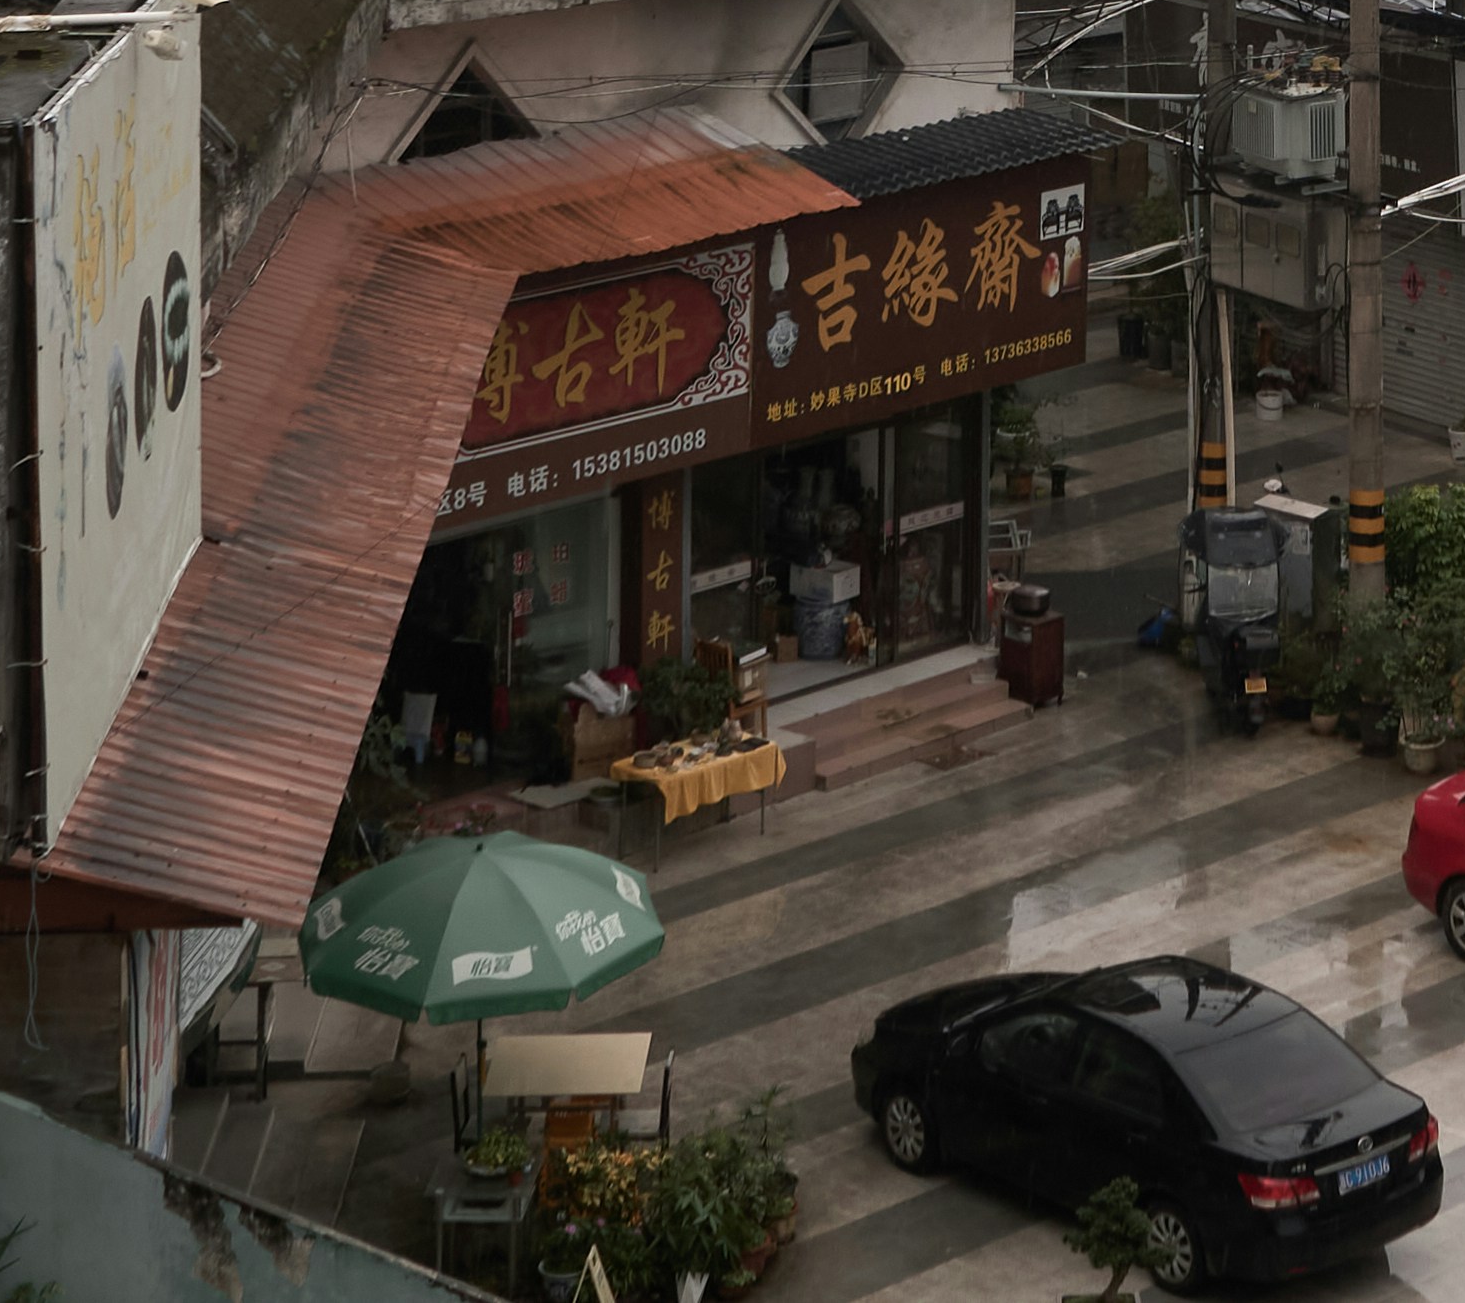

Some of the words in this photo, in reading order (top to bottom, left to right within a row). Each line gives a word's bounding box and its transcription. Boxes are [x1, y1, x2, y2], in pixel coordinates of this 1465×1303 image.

[645, 493, 678, 652] 博古軒
[579, 911, 627, 957] 怡寶
[353, 948, 420, 982] 怡寶
[470, 953, 515, 977] 怡寶
